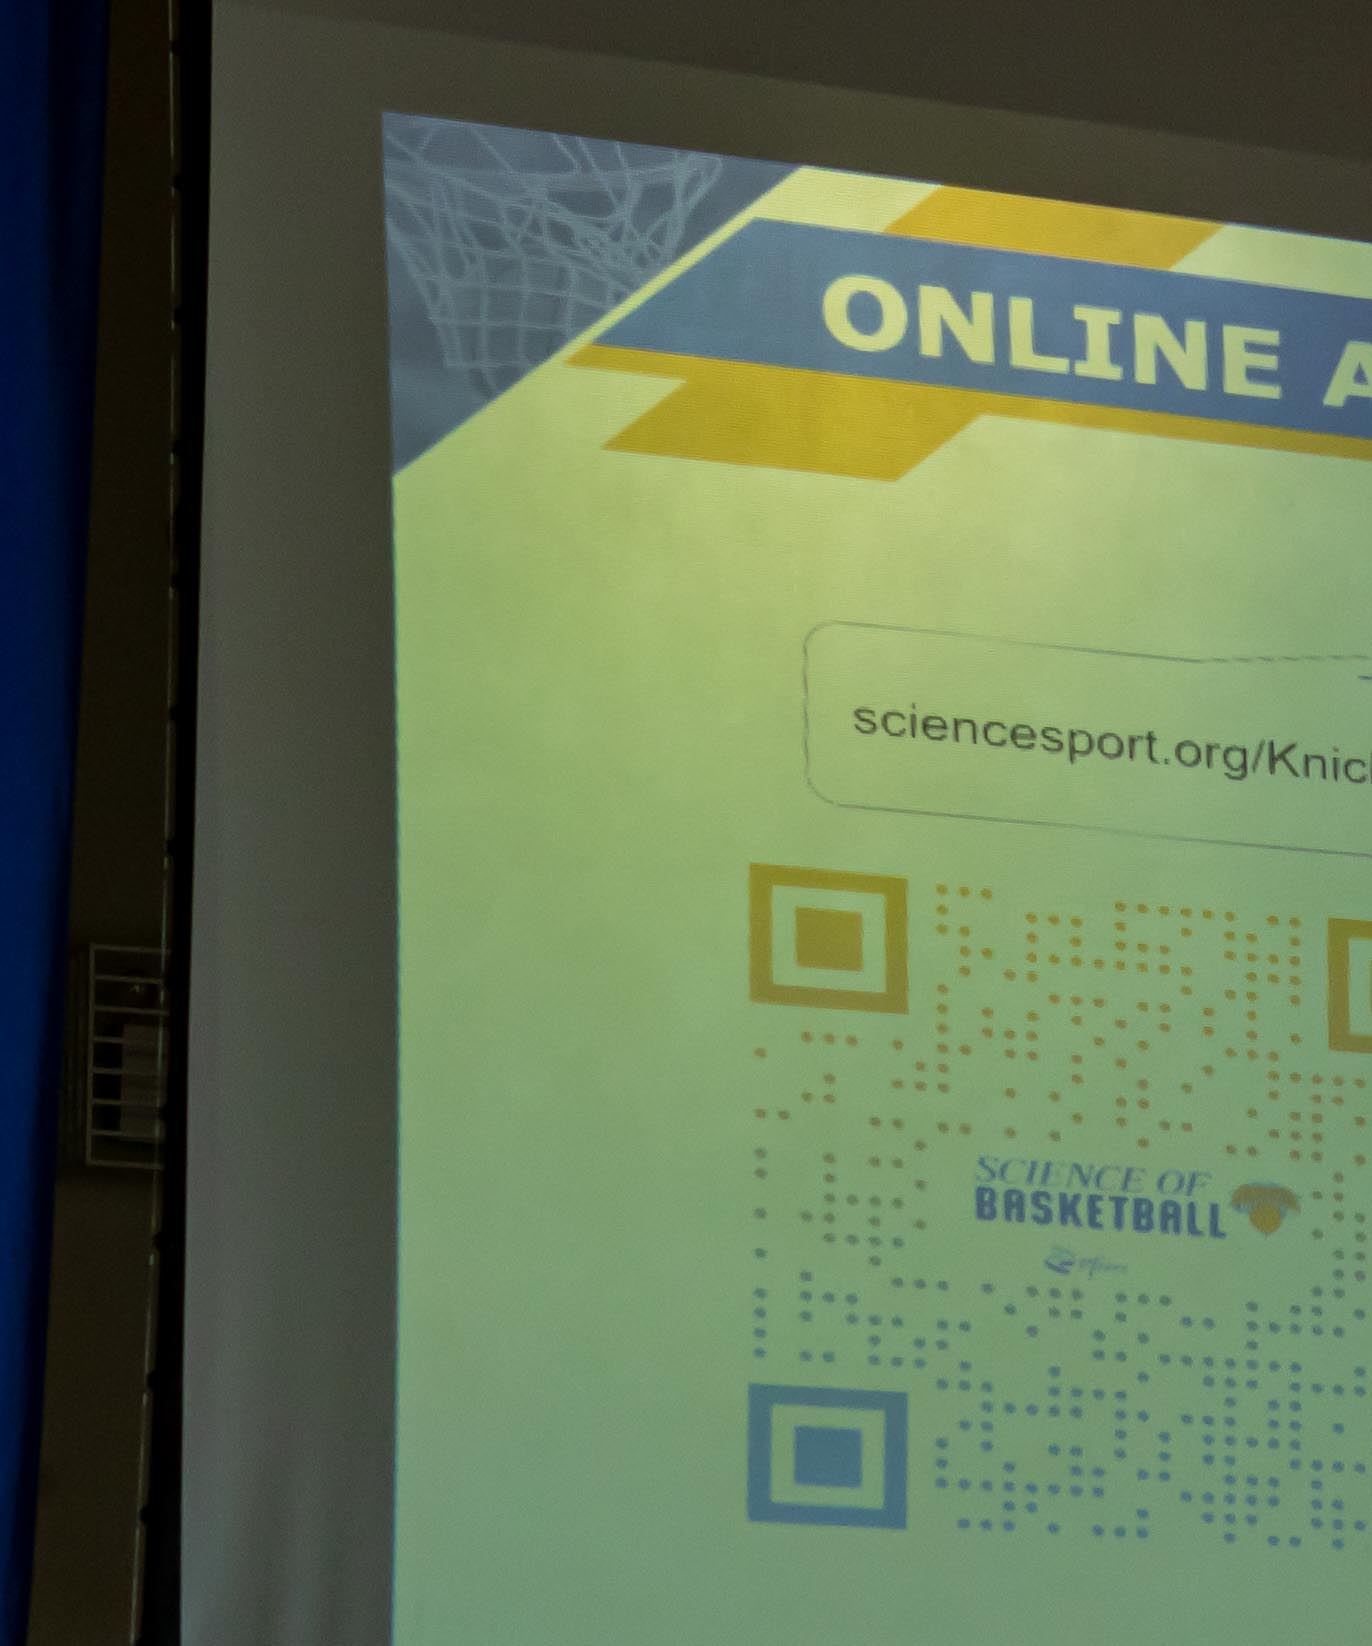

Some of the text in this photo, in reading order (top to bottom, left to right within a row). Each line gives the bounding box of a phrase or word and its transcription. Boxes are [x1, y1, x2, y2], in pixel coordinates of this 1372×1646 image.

[822, 274, 1283, 399] ONLINE
[973, 1154, 1213, 1197] SCIENCE OF
[974, 1186, 1227, 1239] BASKETBALL
